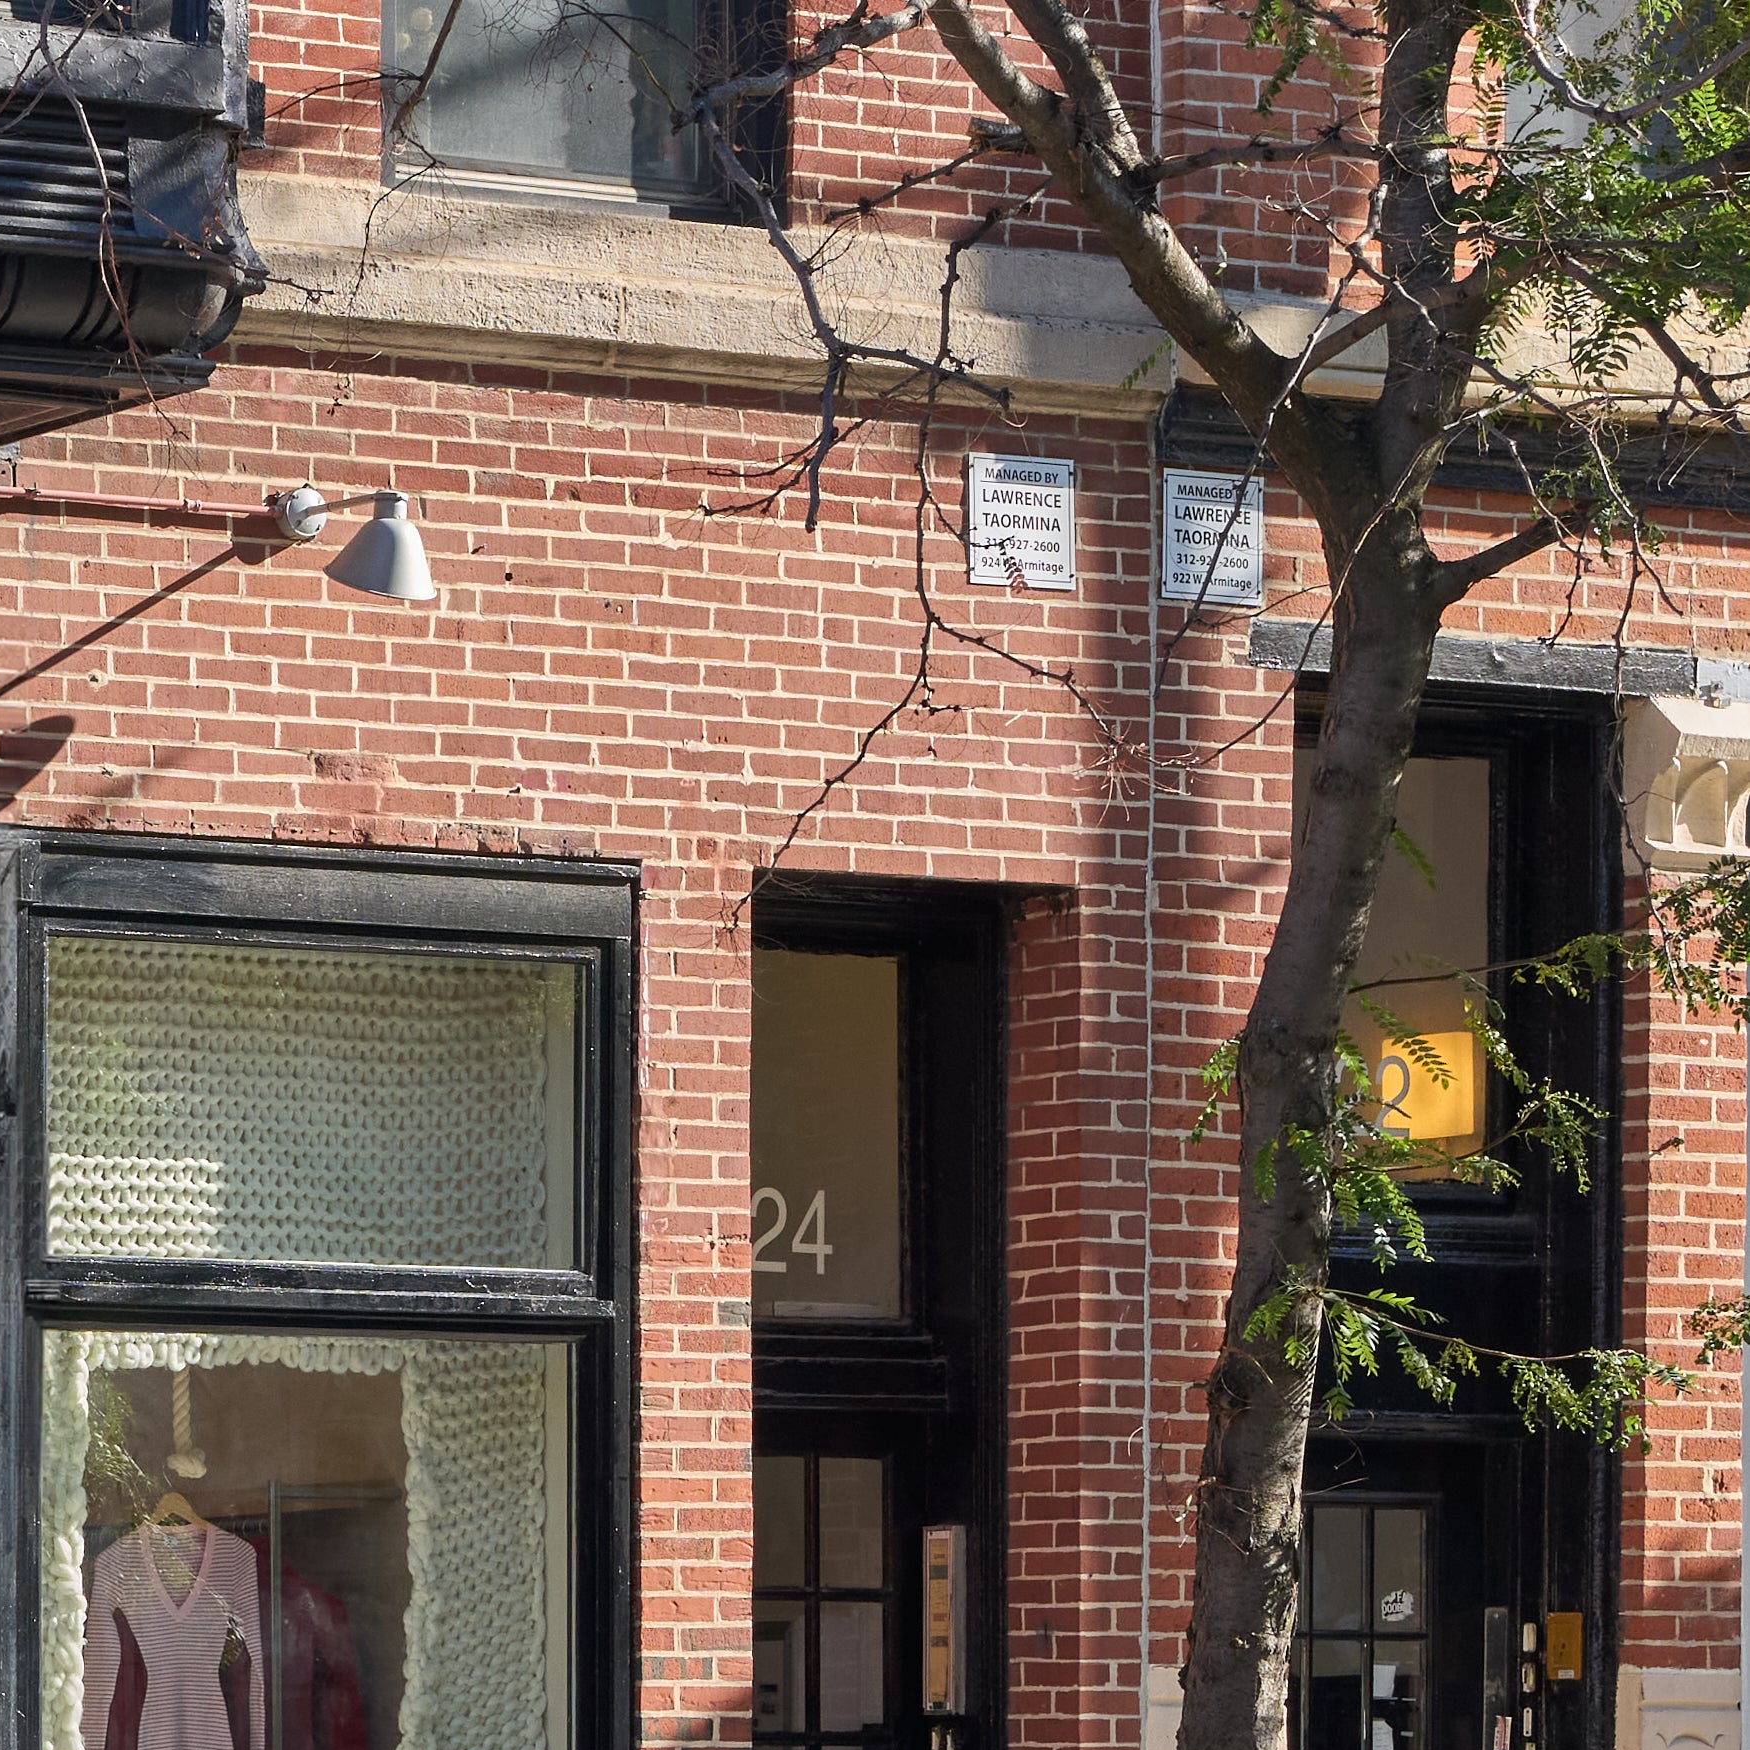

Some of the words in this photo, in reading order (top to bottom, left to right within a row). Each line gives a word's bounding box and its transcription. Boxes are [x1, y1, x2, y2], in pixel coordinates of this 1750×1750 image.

[984, 467, 1041, 482] MANAGED
[1044, 472, 1059, 484] BY
[982, 488, 1062, 508] LAWRENCE
[1177, 484, 1233, 499] MANAGED
[982, 512, 1061, 532] TAORMINA
[981, 556, 1000, 568] 924
[1018, 558, 1064, 574] Armitage
[1176, 553, 1249, 570] 312-92-2600
[1172, 572, 1191, 584] 922
